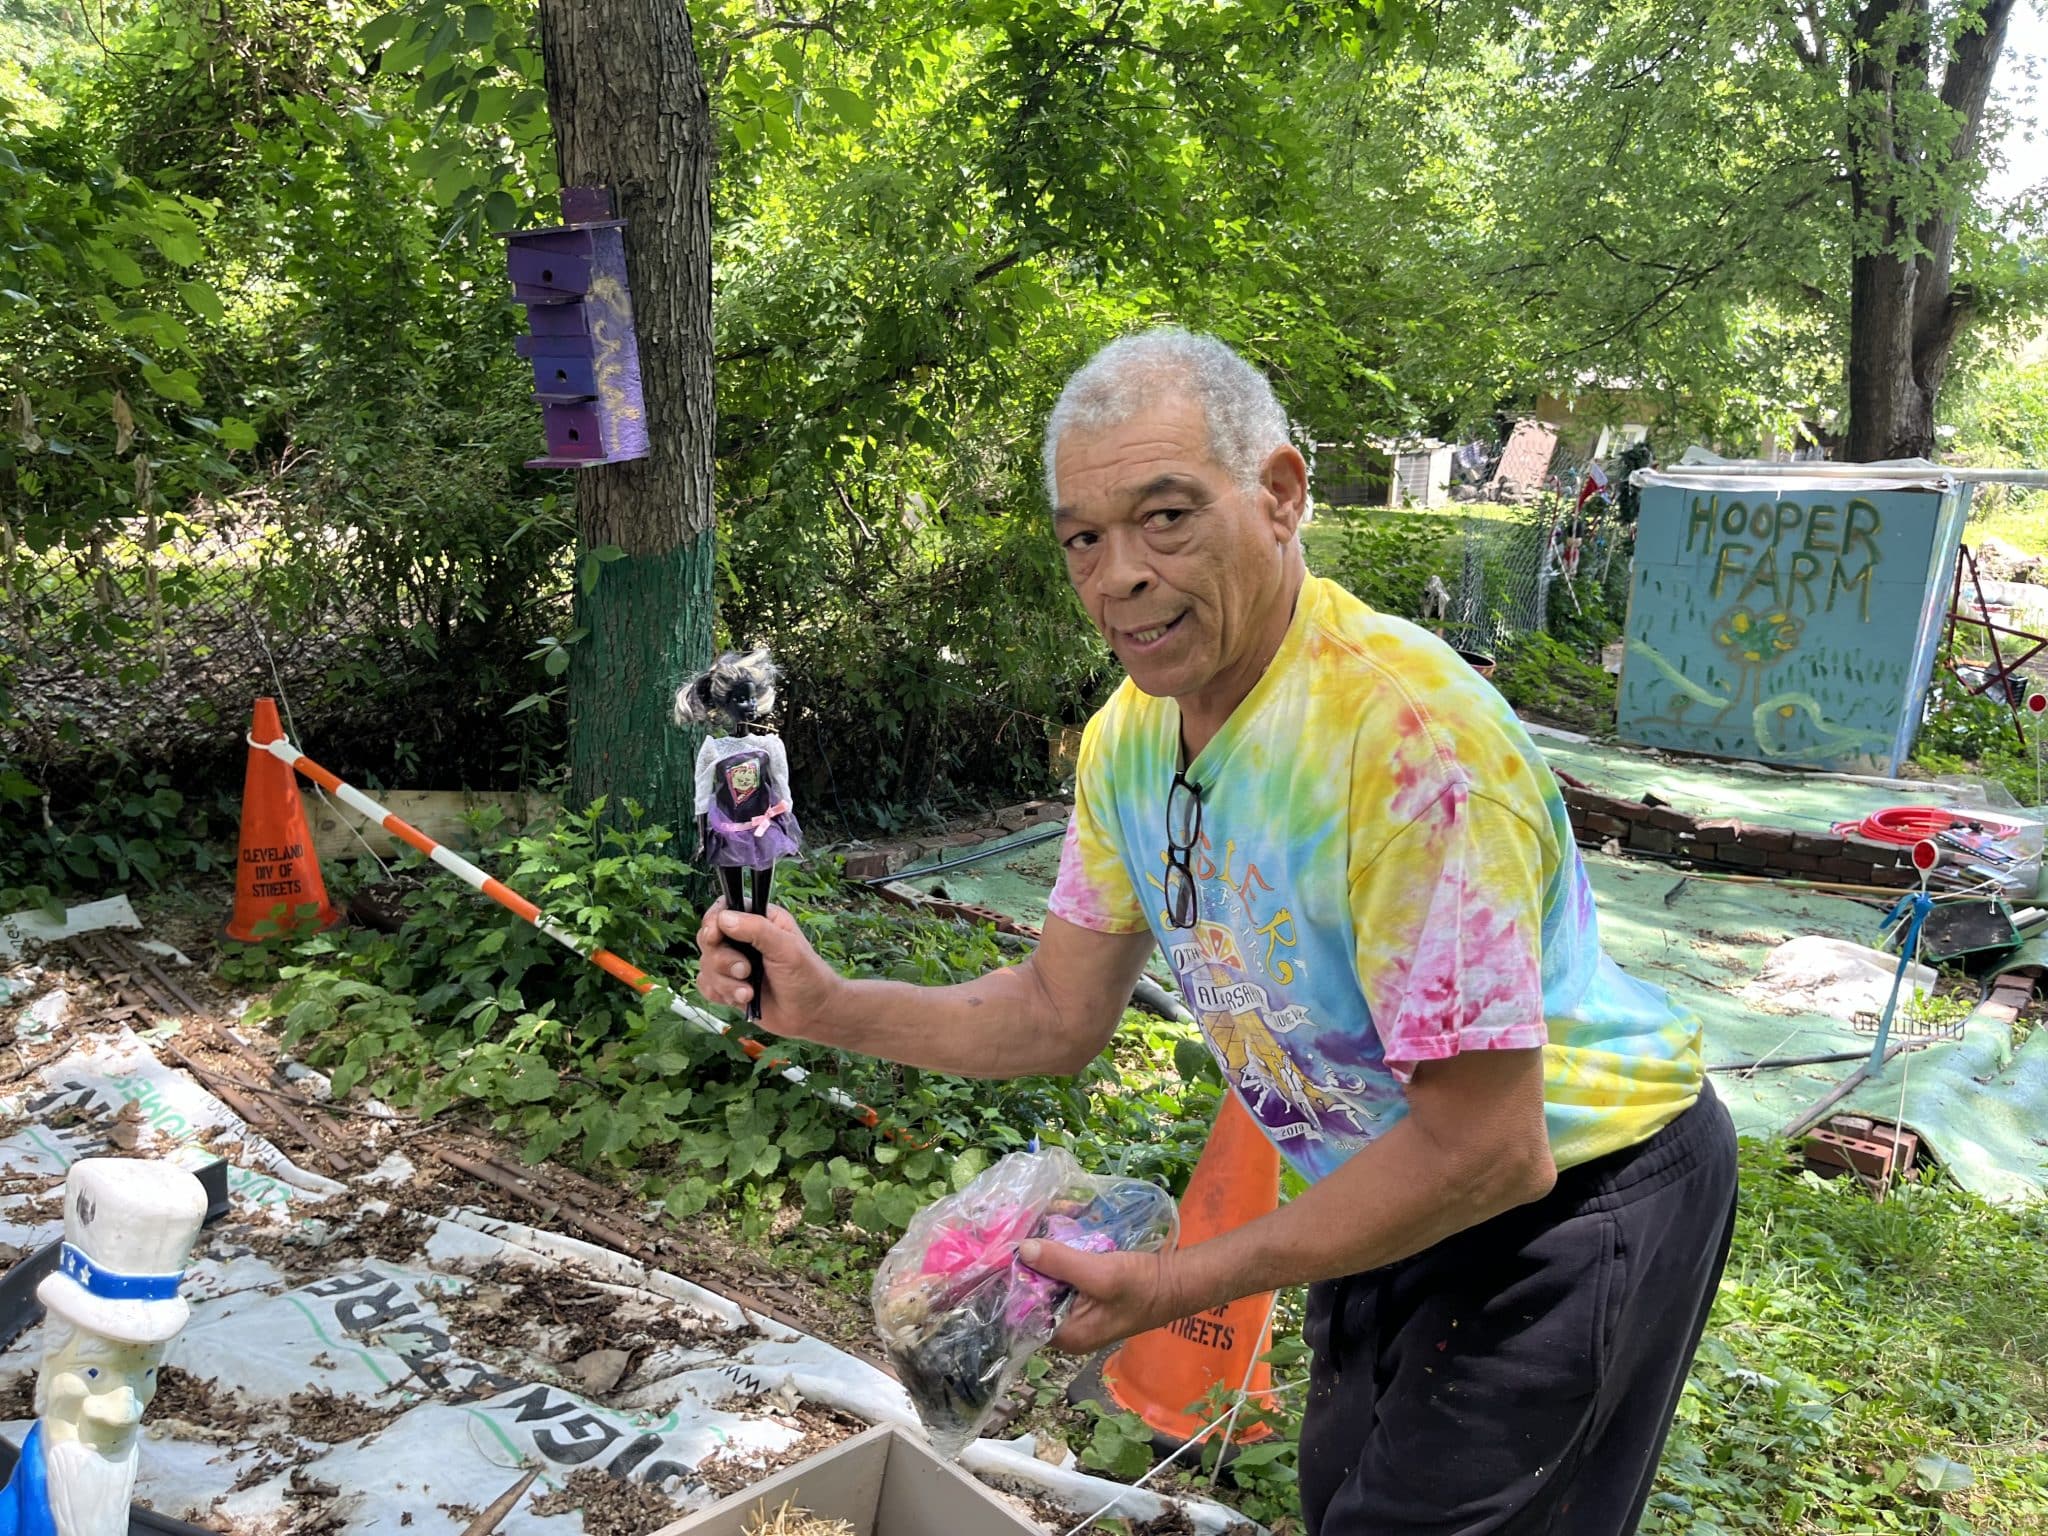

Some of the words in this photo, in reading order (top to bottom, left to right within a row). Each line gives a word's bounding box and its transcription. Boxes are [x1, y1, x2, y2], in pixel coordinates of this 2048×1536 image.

[1686, 494, 1883, 563] HOOPER
[1709, 543, 1878, 623] FARM
[243, 844, 304, 863] CLEVELAND
[255, 865, 273, 880] DIV
[279, 862, 293, 878] OF
[252, 880, 302, 897] STREETS
[1281, 1123, 1304, 1137] 2019
